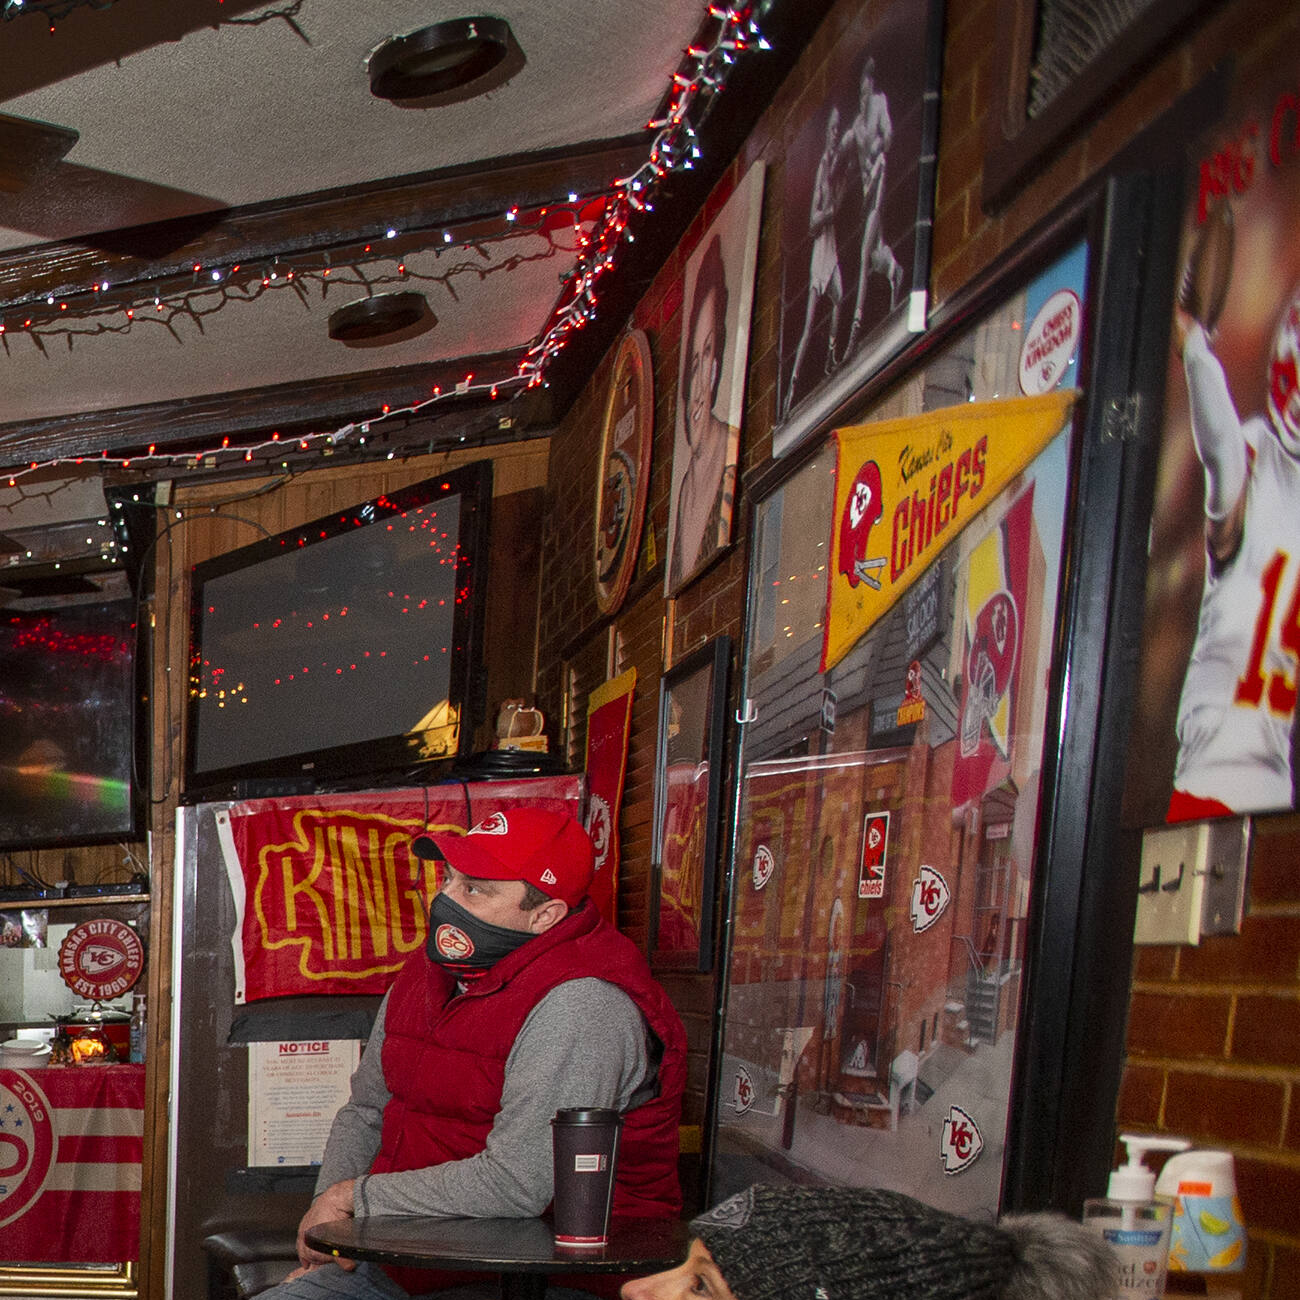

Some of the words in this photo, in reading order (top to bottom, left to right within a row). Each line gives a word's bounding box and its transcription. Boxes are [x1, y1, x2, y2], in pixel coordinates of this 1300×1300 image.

[919, 879, 941, 916] KC
[63, 929, 88, 974] KANSAS
[88, 922, 118, 936] CITY
[118, 930, 140, 969] CHIEFS
[90, 951, 114, 966] KC
[74, 978, 96, 997] EST.
[99, 976, 128, 997] 1960
[279, 1042, 330, 1053] NOTICE
[12, 1082, 46, 1123] 2019
[949, 1116, 981, 1160] KC
